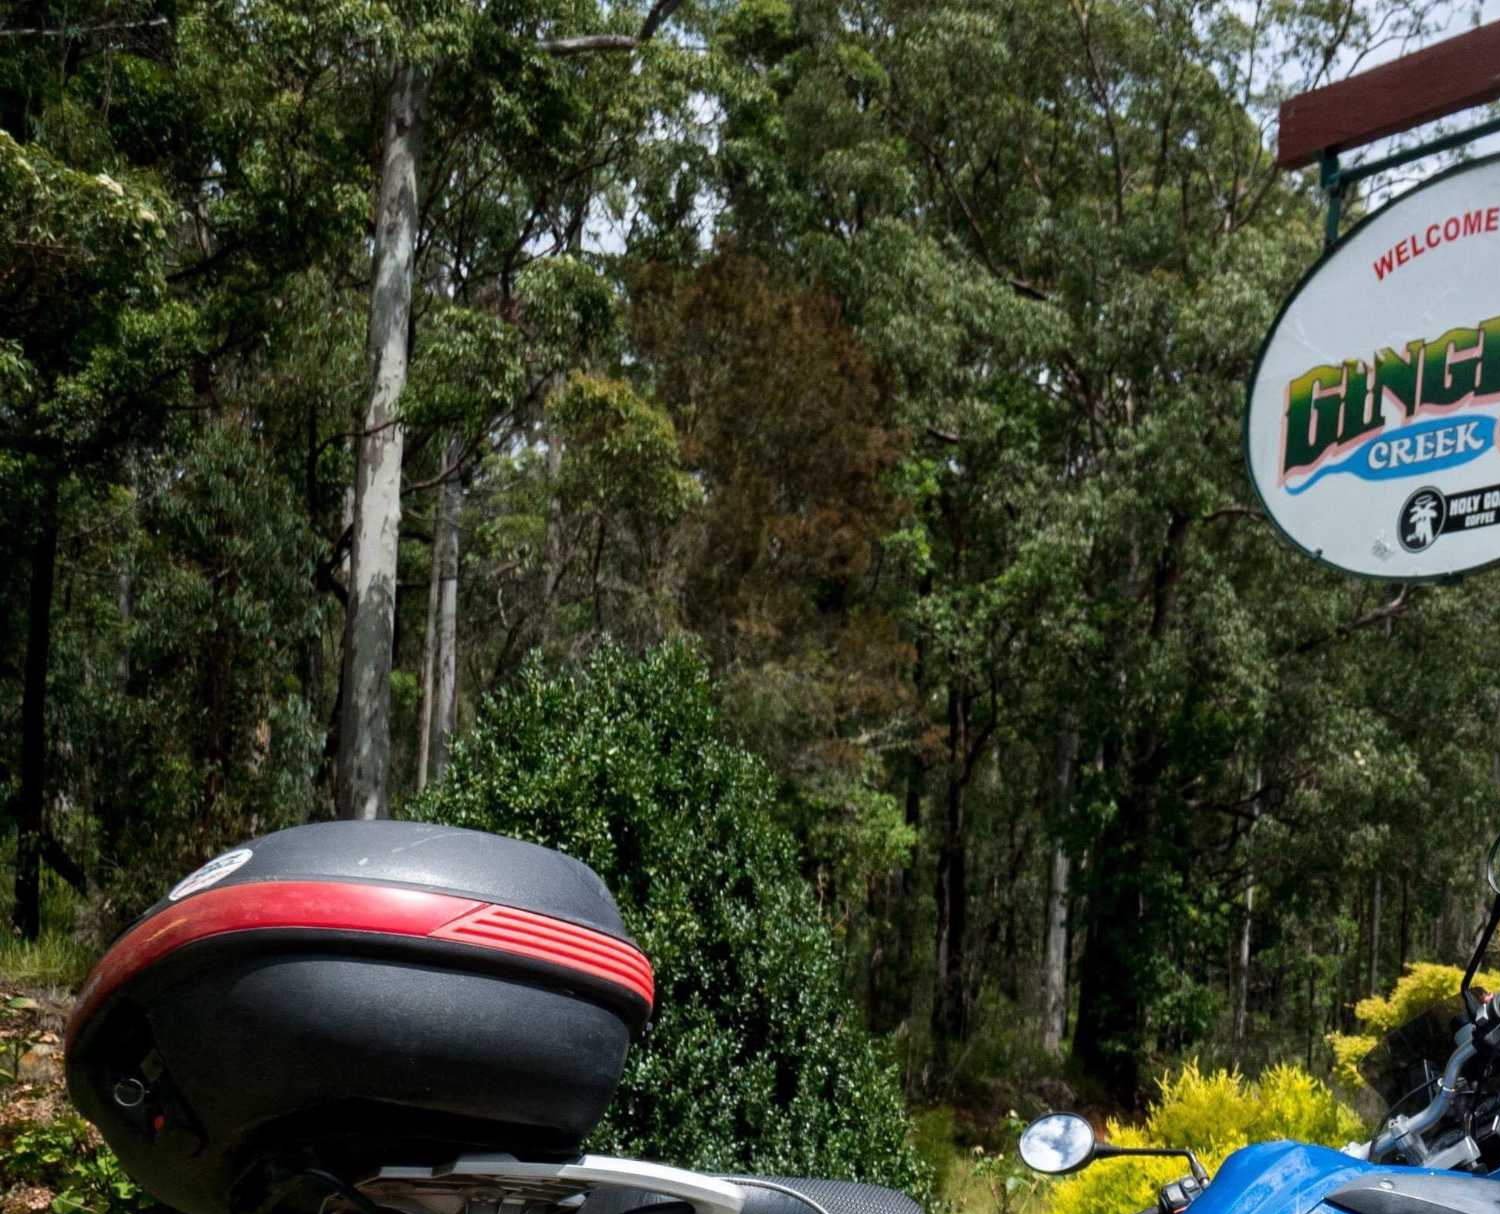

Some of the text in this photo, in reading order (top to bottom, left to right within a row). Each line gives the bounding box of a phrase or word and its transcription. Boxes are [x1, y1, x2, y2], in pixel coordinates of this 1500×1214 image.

[1373, 207, 1500, 281] WELCOME
[1368, 420, 1485, 470] CREEK
[1449, 494, 1482, 516] HOLY
[1464, 510, 1497, 528] COFFEE
